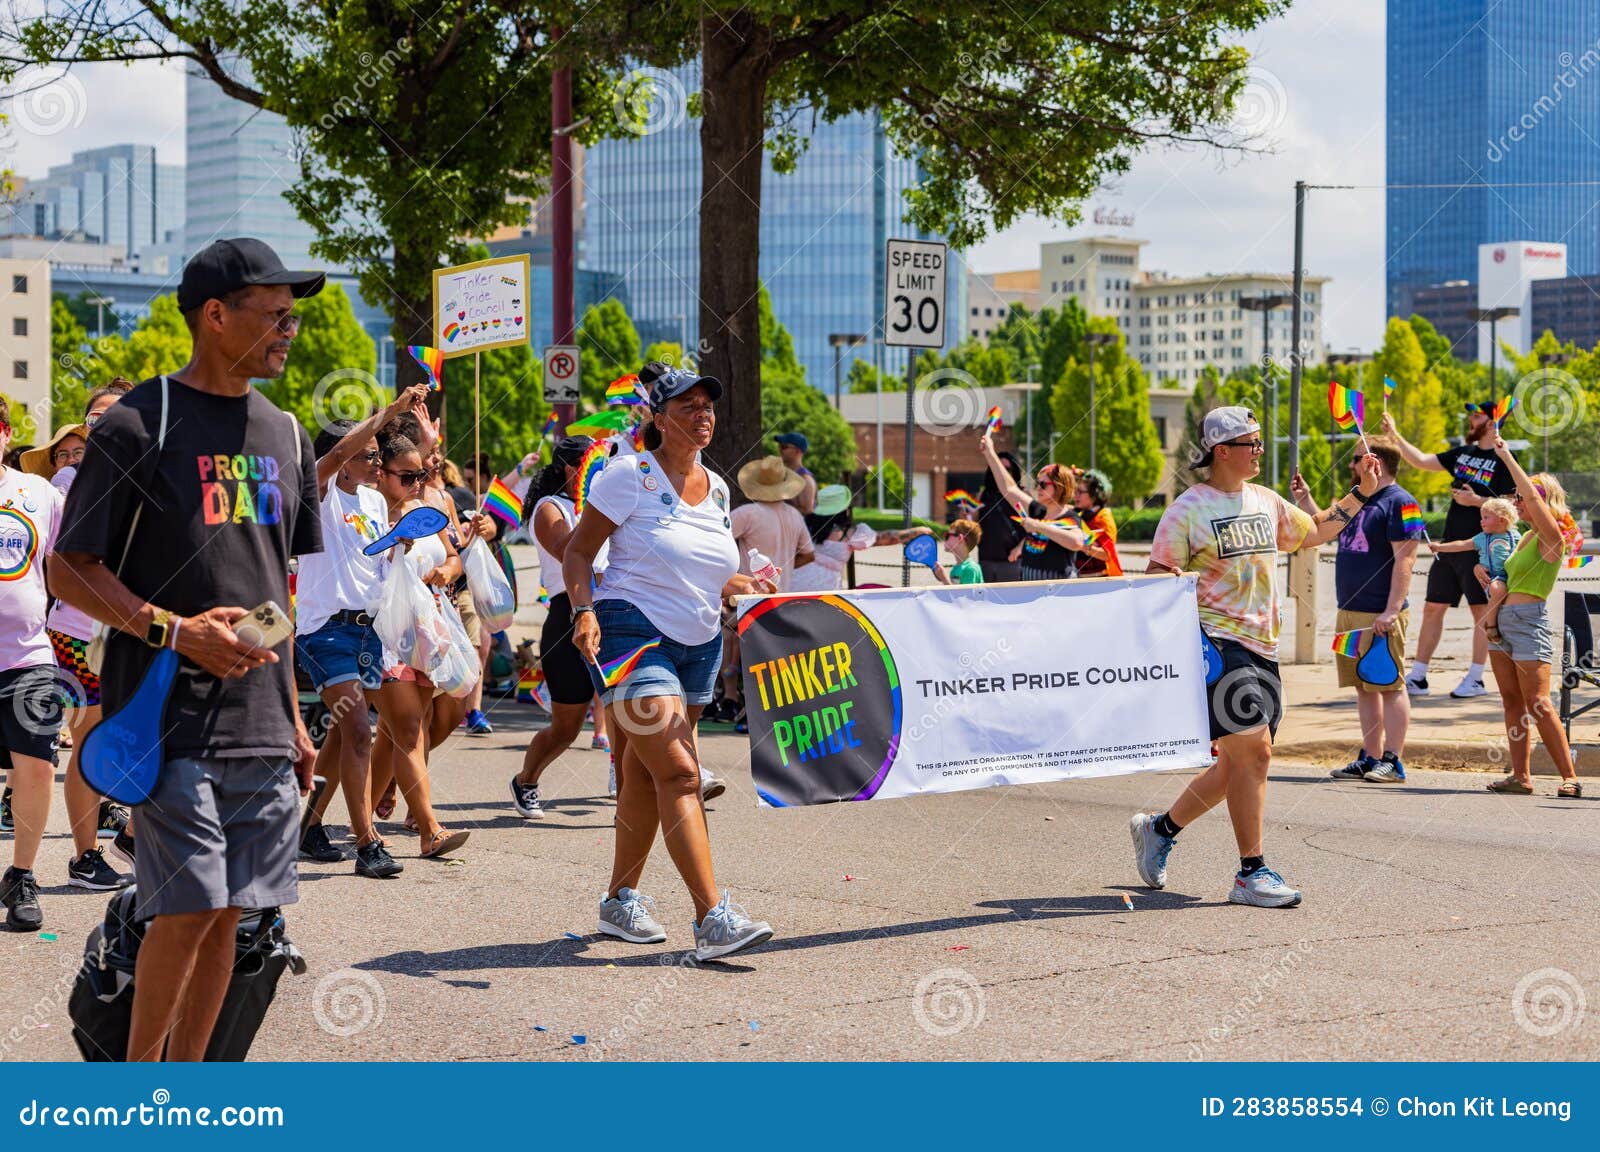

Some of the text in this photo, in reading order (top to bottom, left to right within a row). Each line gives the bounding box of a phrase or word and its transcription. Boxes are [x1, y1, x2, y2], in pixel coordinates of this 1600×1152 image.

[892, 251, 942, 270] SPEED
[897, 273, 936, 290] LIMIT
[463, 288, 491, 303] Pride
[892, 295, 940, 334] 30
[197, 454, 280, 481] PROUD
[1480, 459, 1497, 472] ALL
[201, 481, 283, 525] DAD
[7, 538, 22, 549] AFB
[1228, 520, 1269, 548] USO
[749, 641, 858, 712] TINKER
[916, 664, 1179, 698] TINKER PRIDE COUNCIL
[773, 700, 862, 768] PRIDE
[949, 759, 978, 767] PRIVATE
[1113, 742, 1159, 752] DEPARTMENT
[1169, 738, 1200, 747] DEFENSE
[994, 762, 1043, 771] COMPONENTS
[1094, 752, 1150, 762] GOVERNMENTAL
